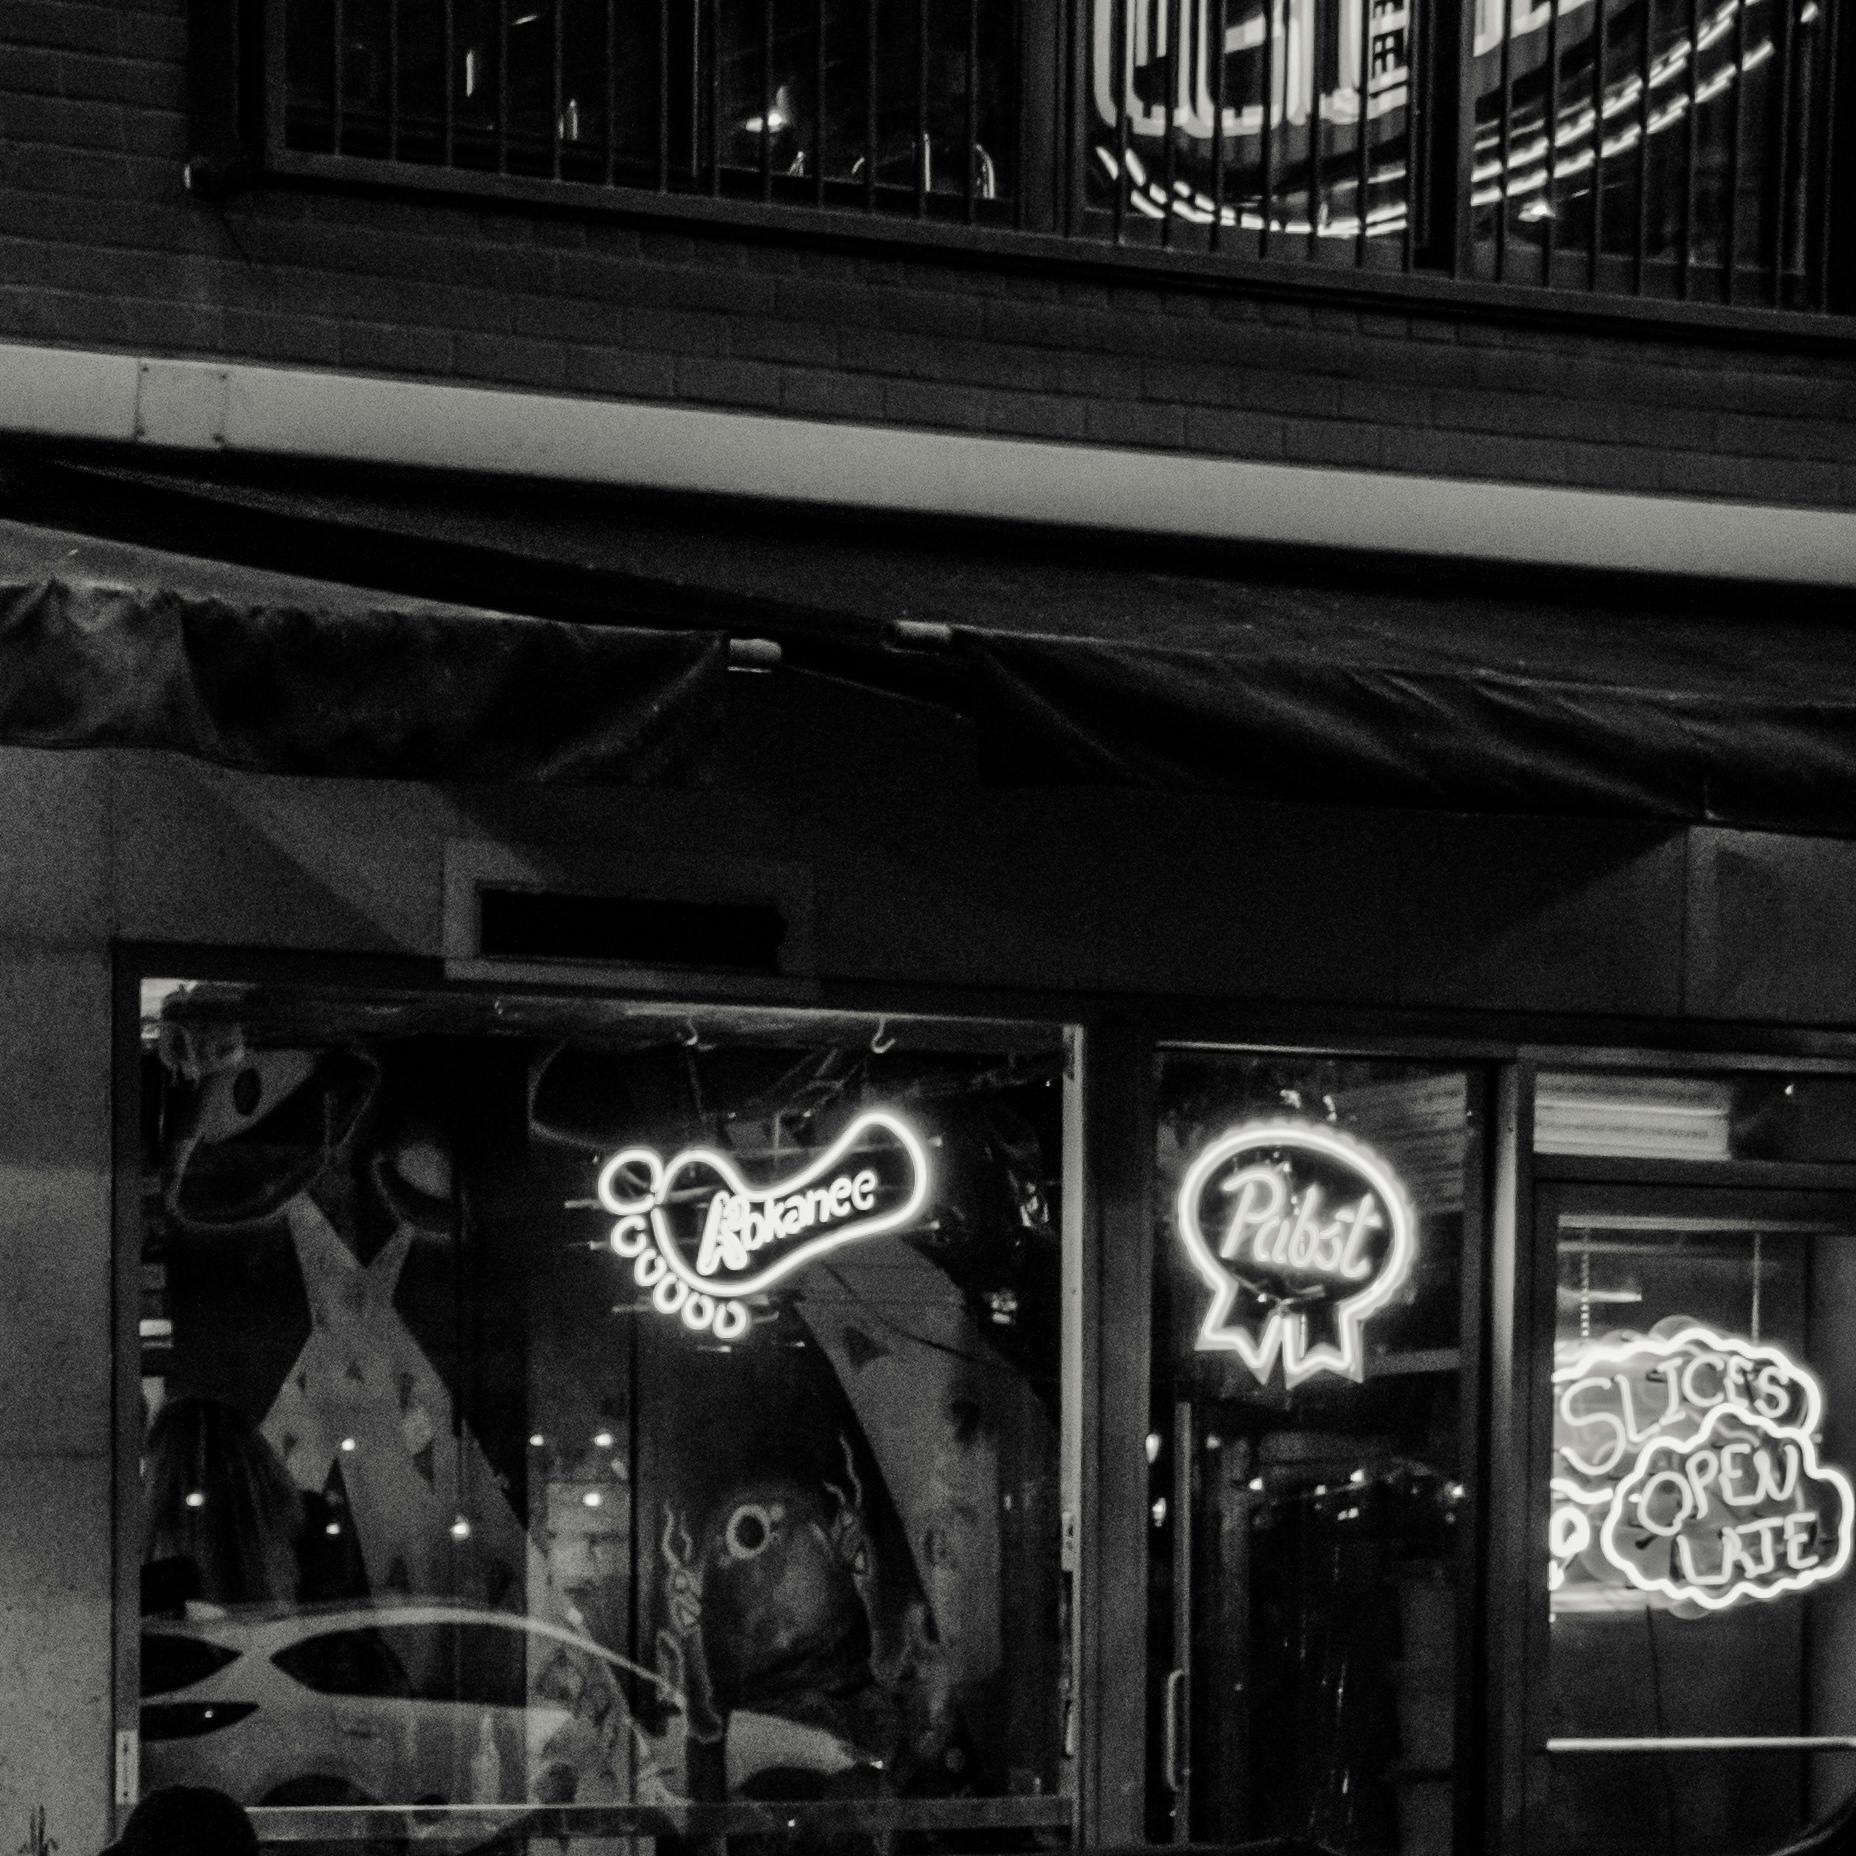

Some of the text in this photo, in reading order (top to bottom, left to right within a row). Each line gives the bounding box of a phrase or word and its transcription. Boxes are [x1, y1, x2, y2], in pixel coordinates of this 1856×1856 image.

[1220, 1162, 1383, 1279] Pabst
[1559, 1353, 1791, 1476] SLICES
[1636, 1442, 1799, 1537] OPEN
[1674, 1511, 1819, 1586] LATE
